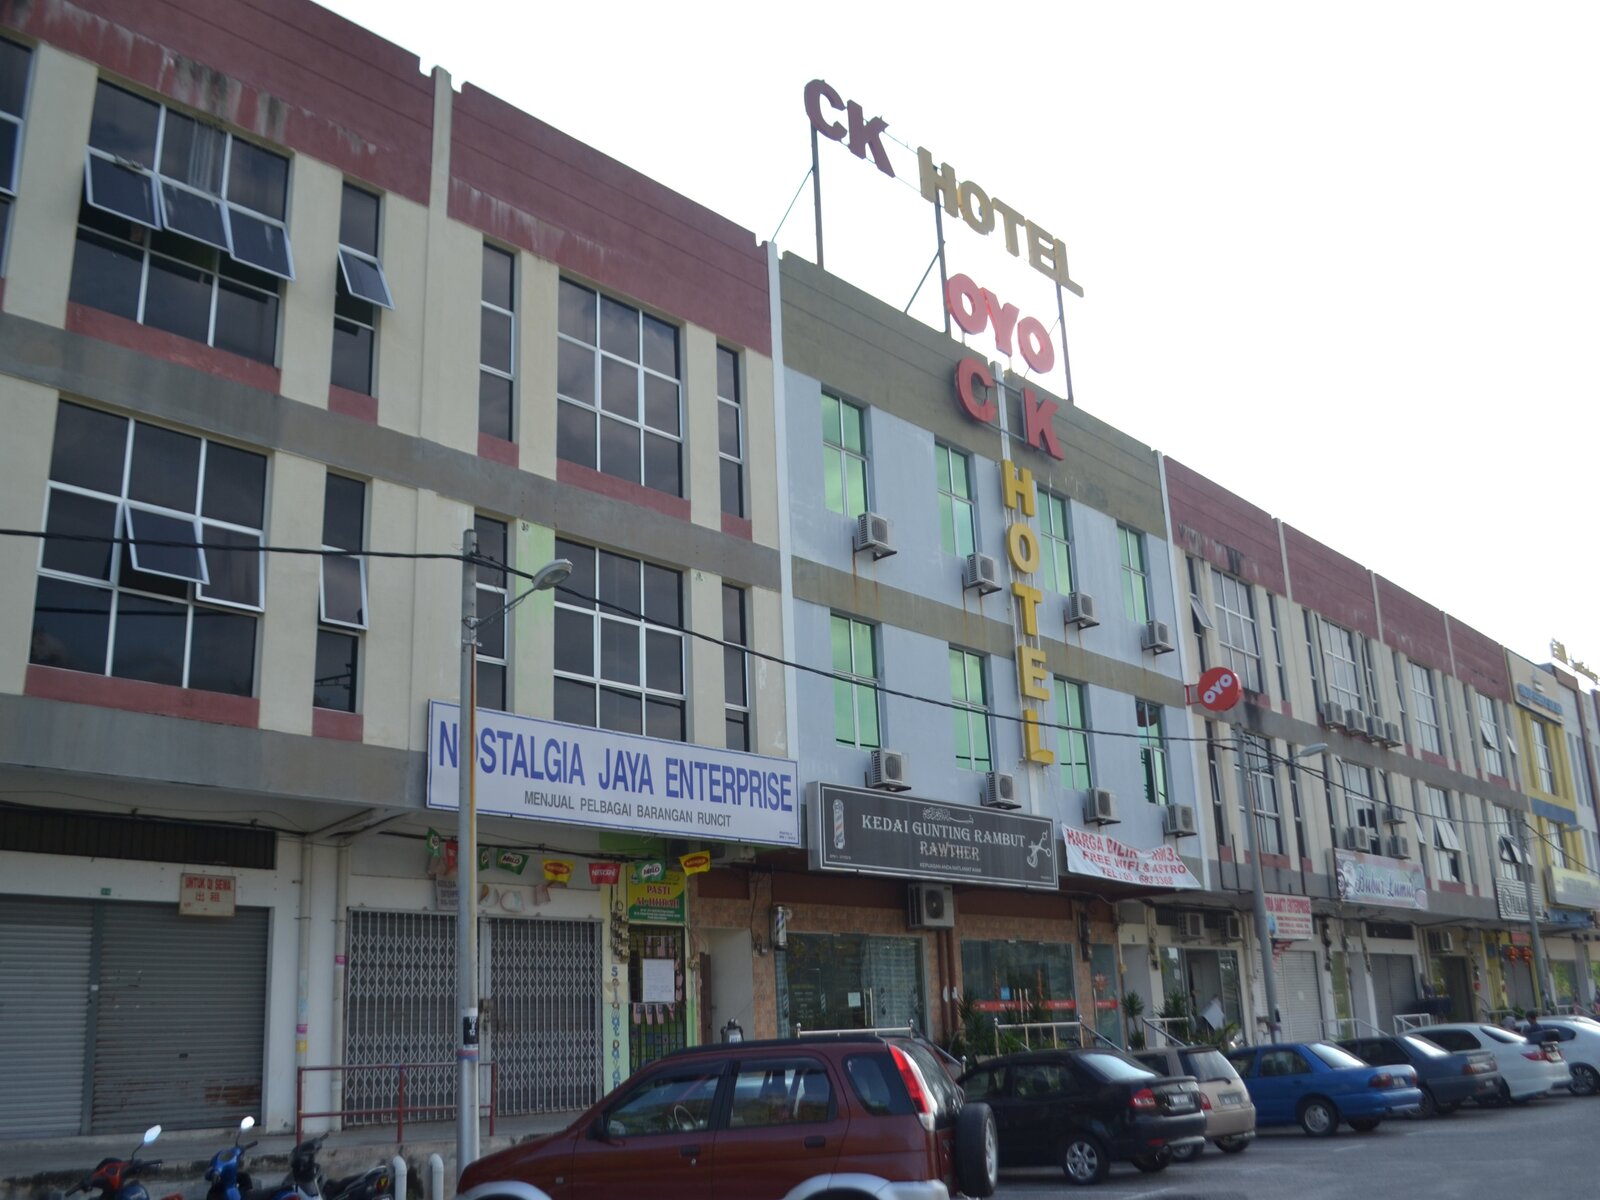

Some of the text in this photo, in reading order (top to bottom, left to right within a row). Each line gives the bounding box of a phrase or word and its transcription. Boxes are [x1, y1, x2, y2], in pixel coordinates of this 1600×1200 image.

[803, 78, 1085, 298] CK HOTEL
[945, 272, 1055, 375] OYO
[1001, 458, 1054, 766] HOTEL
[1202, 673, 1233, 705] OYO
[439, 720, 793, 812] NSTALGIA JAYA ENTERPRISE
[524, 789, 732, 828] MENJUAL PELBAGAI BARANGAN RUNCIT
[861, 814, 910, 834] KEDAI
[911, 821, 971, 842] GUNTING
[973, 828, 1026, 848] RAMBUT
[1065, 828, 1105, 852] HARGA
[501, 855, 520, 865] MILO
[919, 840, 981, 861] RAWTHER
[1082, 850, 1187, 875] FREE WIFI & ASTRO
[643, 866, 660, 875] MILO
[1102, 866, 1118, 878] TEL
[646, 884, 671, 895] PASTI
